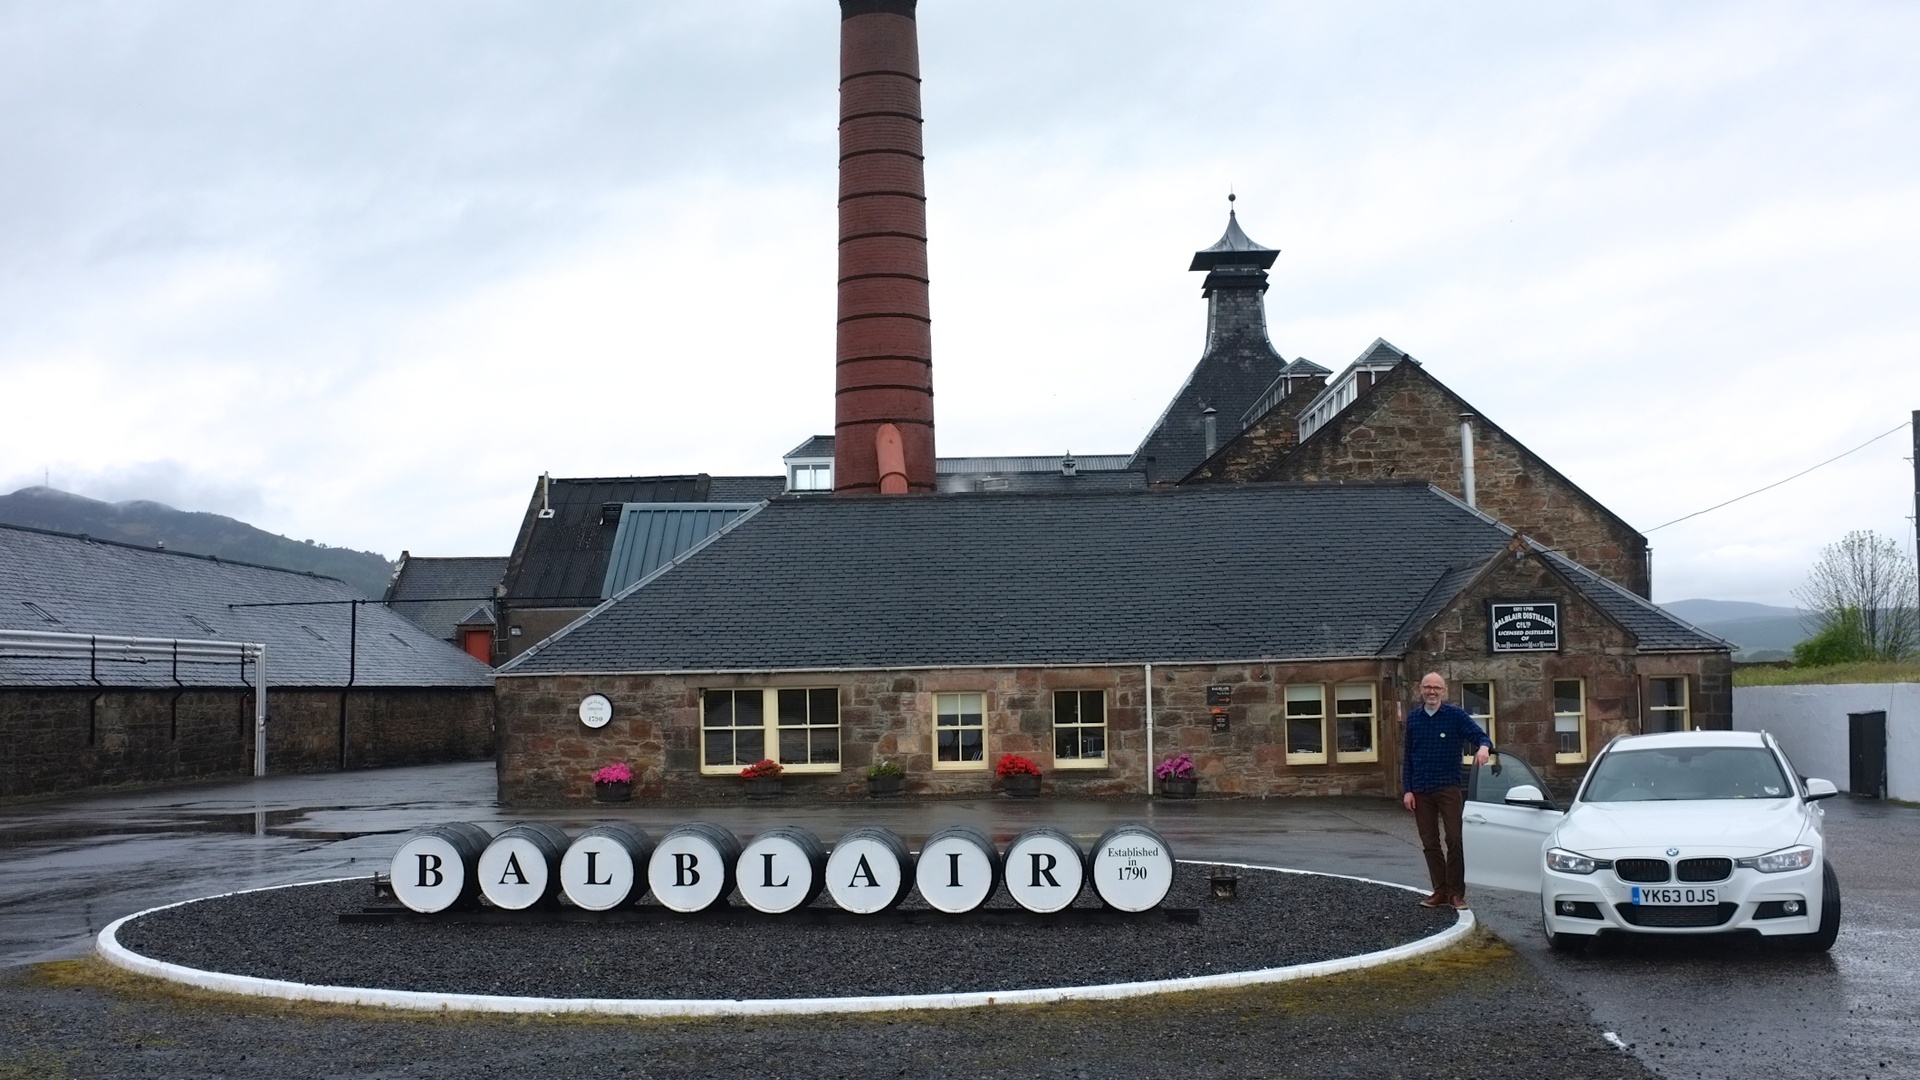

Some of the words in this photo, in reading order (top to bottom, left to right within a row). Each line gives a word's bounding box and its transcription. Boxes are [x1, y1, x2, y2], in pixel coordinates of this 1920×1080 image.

[1494, 612, 1522, 629] BALBLAIR
[1522, 612, 1556, 628] DISTILLERY
[1108, 846, 1159, 857] Established
[1128, 857, 1137, 866] in
[1118, 866, 1148, 880] 1790
[1642, 889, 1682, 903] YK63
[1685, 889, 1716, 903] OJS
